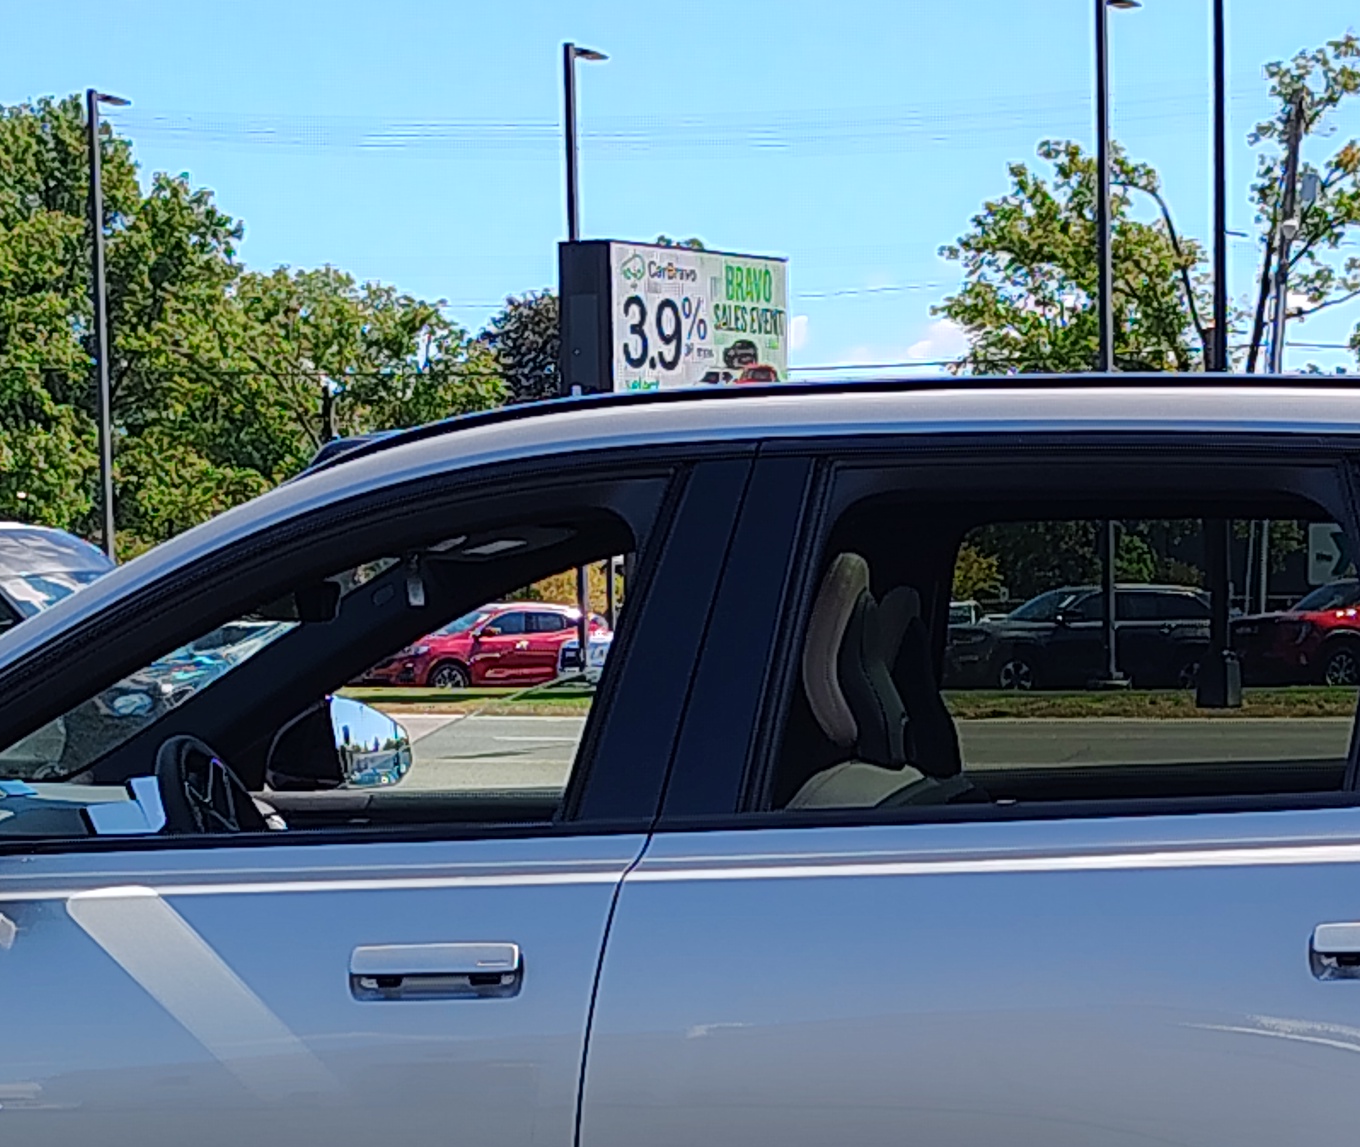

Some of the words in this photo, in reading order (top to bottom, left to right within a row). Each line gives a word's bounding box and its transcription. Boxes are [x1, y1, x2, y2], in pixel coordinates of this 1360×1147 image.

[647, 260, 698, 283] CarBravo
[724, 263, 773, 304] BRAVO
[622, 294, 708, 371] 3.9%
[713, 302, 748, 334] SALES
[749, 305, 786, 337] EVENT
